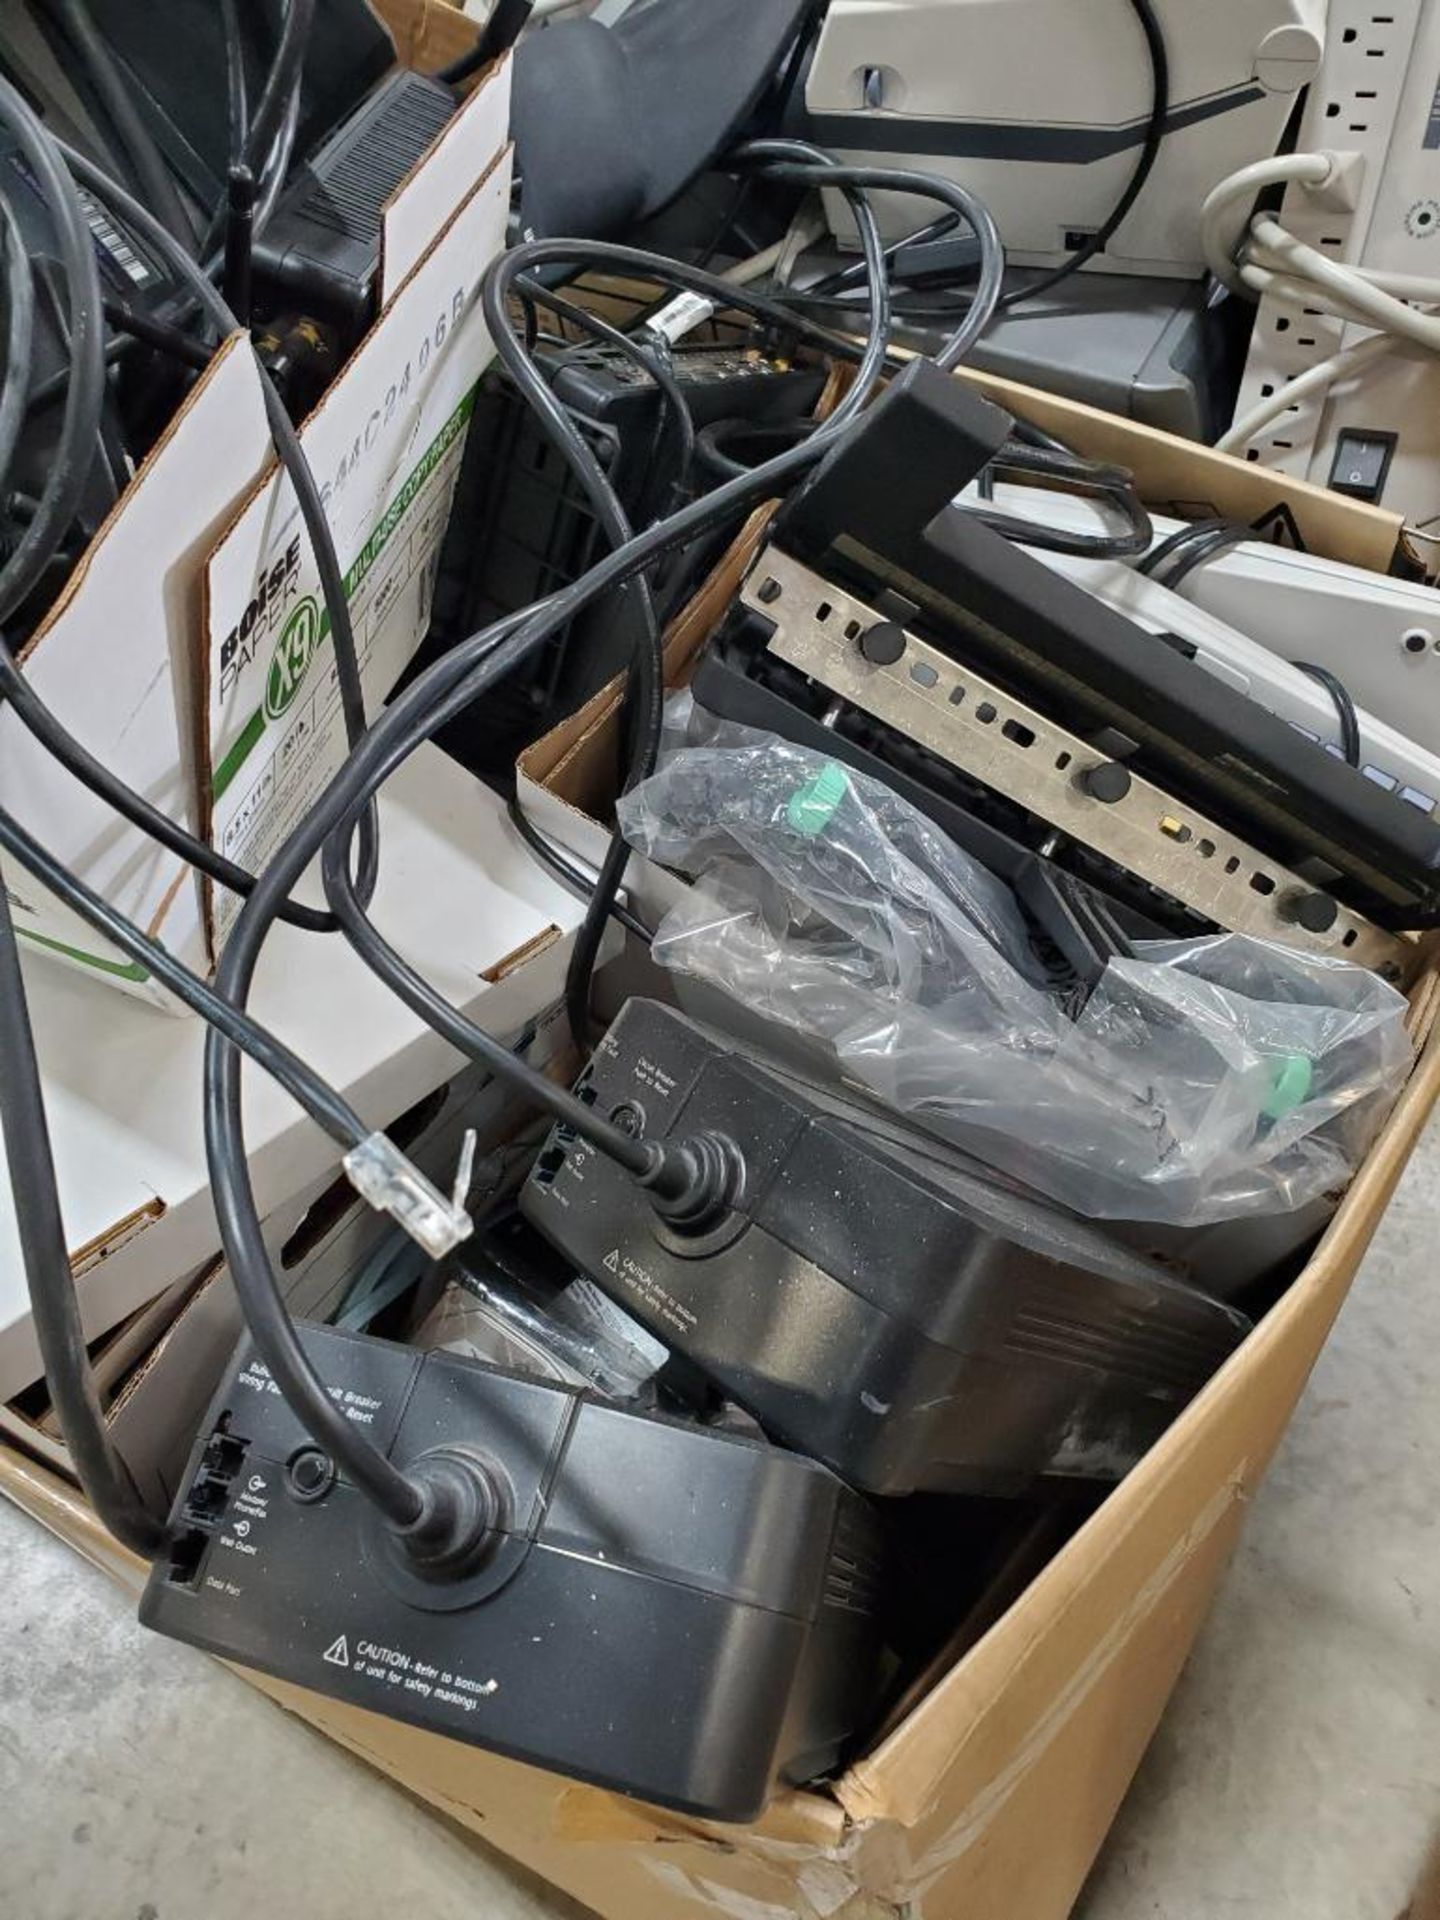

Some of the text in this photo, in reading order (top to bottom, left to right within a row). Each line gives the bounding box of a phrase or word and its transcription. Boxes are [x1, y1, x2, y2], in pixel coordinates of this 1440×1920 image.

[220, 567, 300, 705] PAPER
[344, 1391, 382, 1410] Breaker
[346, 1406, 375, 1424] Reset
[353, 1661, 366, 1673] of
[366, 1665, 385, 1680] unit
[388, 1670, 402, 1685] for
[404, 1677, 432, 1698] safety
[414, 1661, 439, 1679] Refer
[441, 1671, 452, 1684] to
